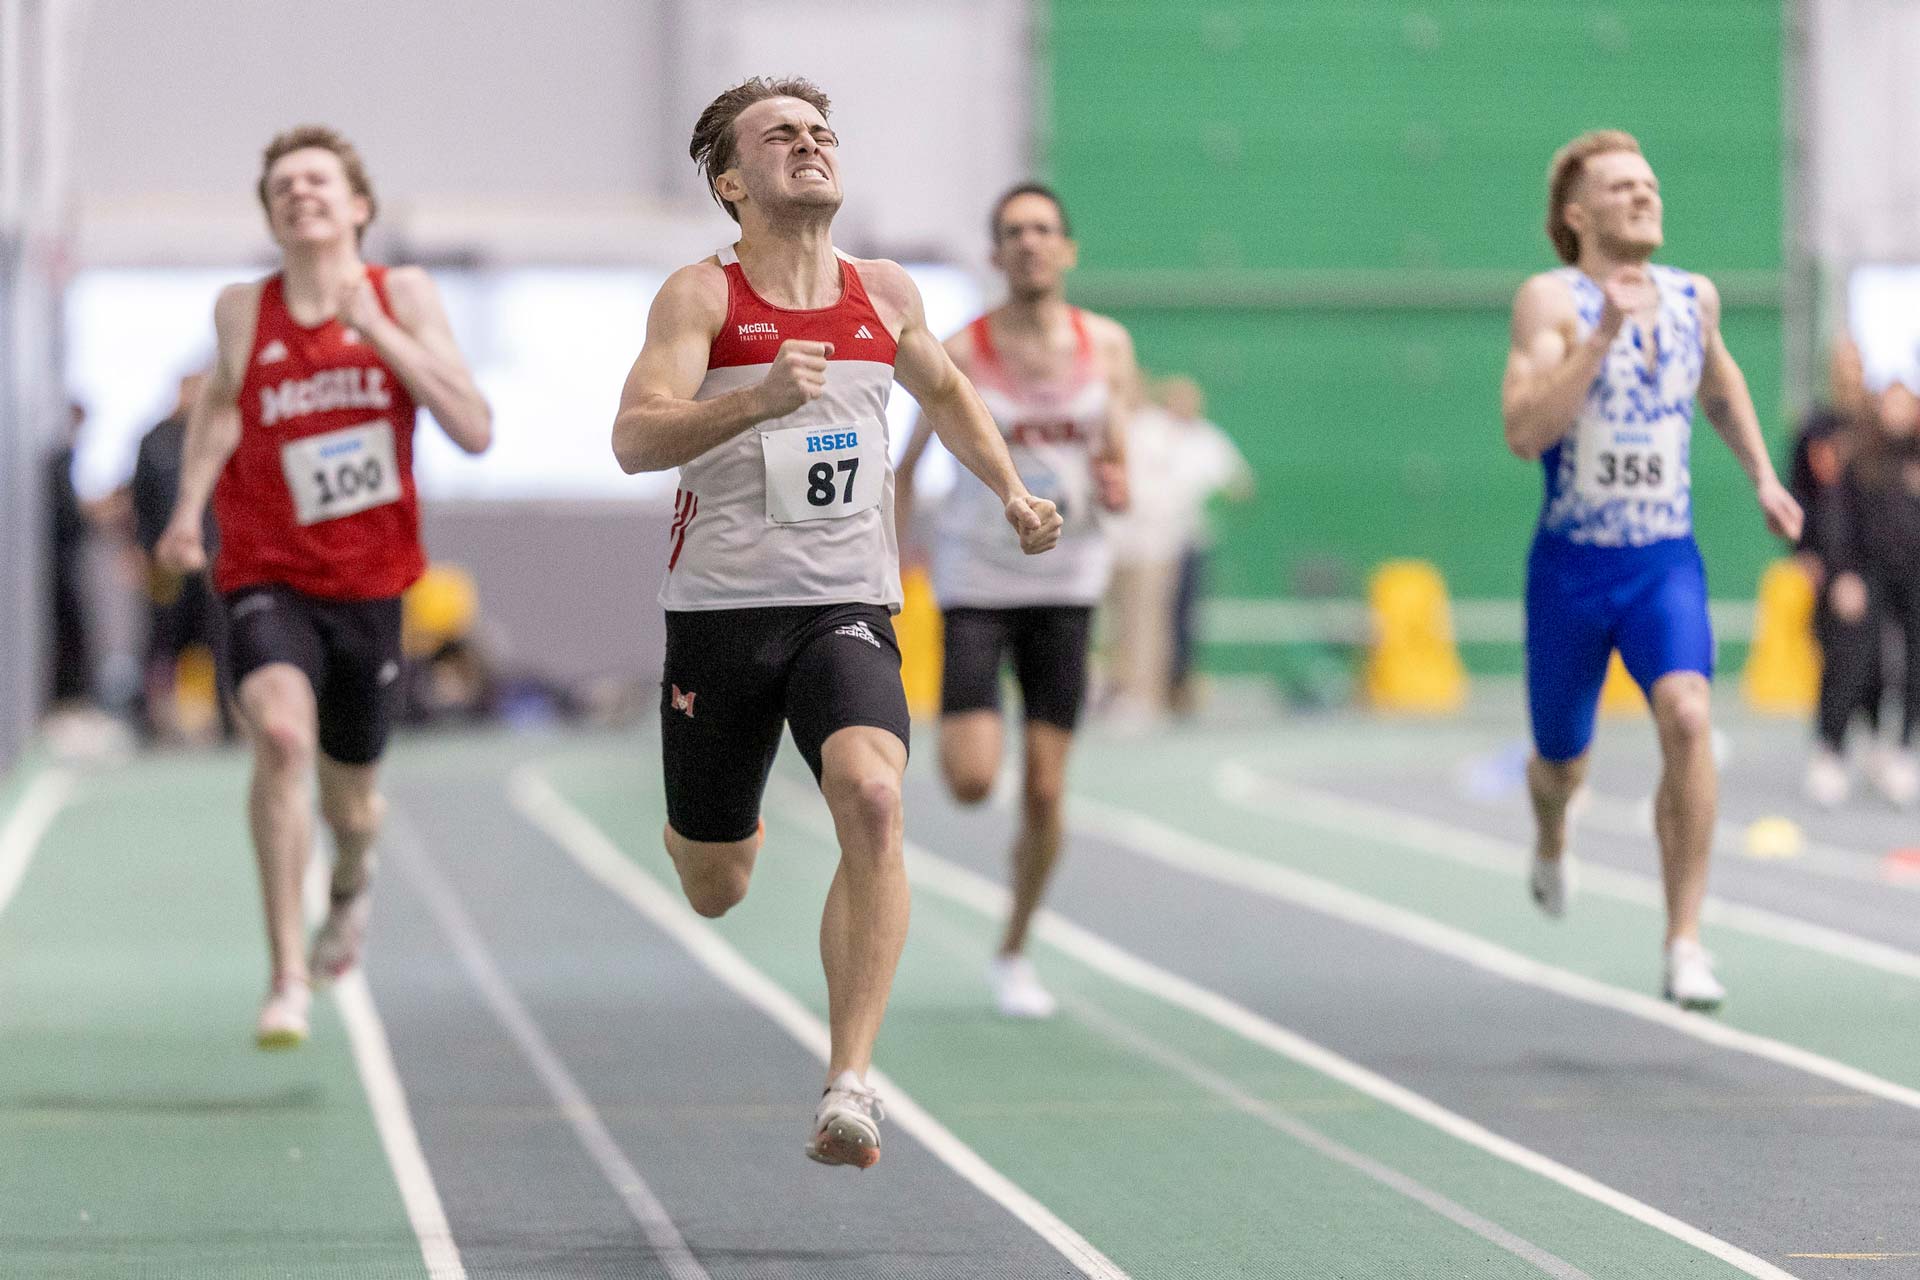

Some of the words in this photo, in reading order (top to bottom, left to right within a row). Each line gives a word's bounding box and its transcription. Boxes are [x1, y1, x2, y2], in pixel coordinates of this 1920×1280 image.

[738, 323, 778, 335] McGILL
[806, 432, 858, 453] RSEQ
[313, 456, 382, 506] 100
[807, 457, 859, 507] 87
[1597, 450, 1664, 487] 358
[834, 629, 881, 649] adidas
